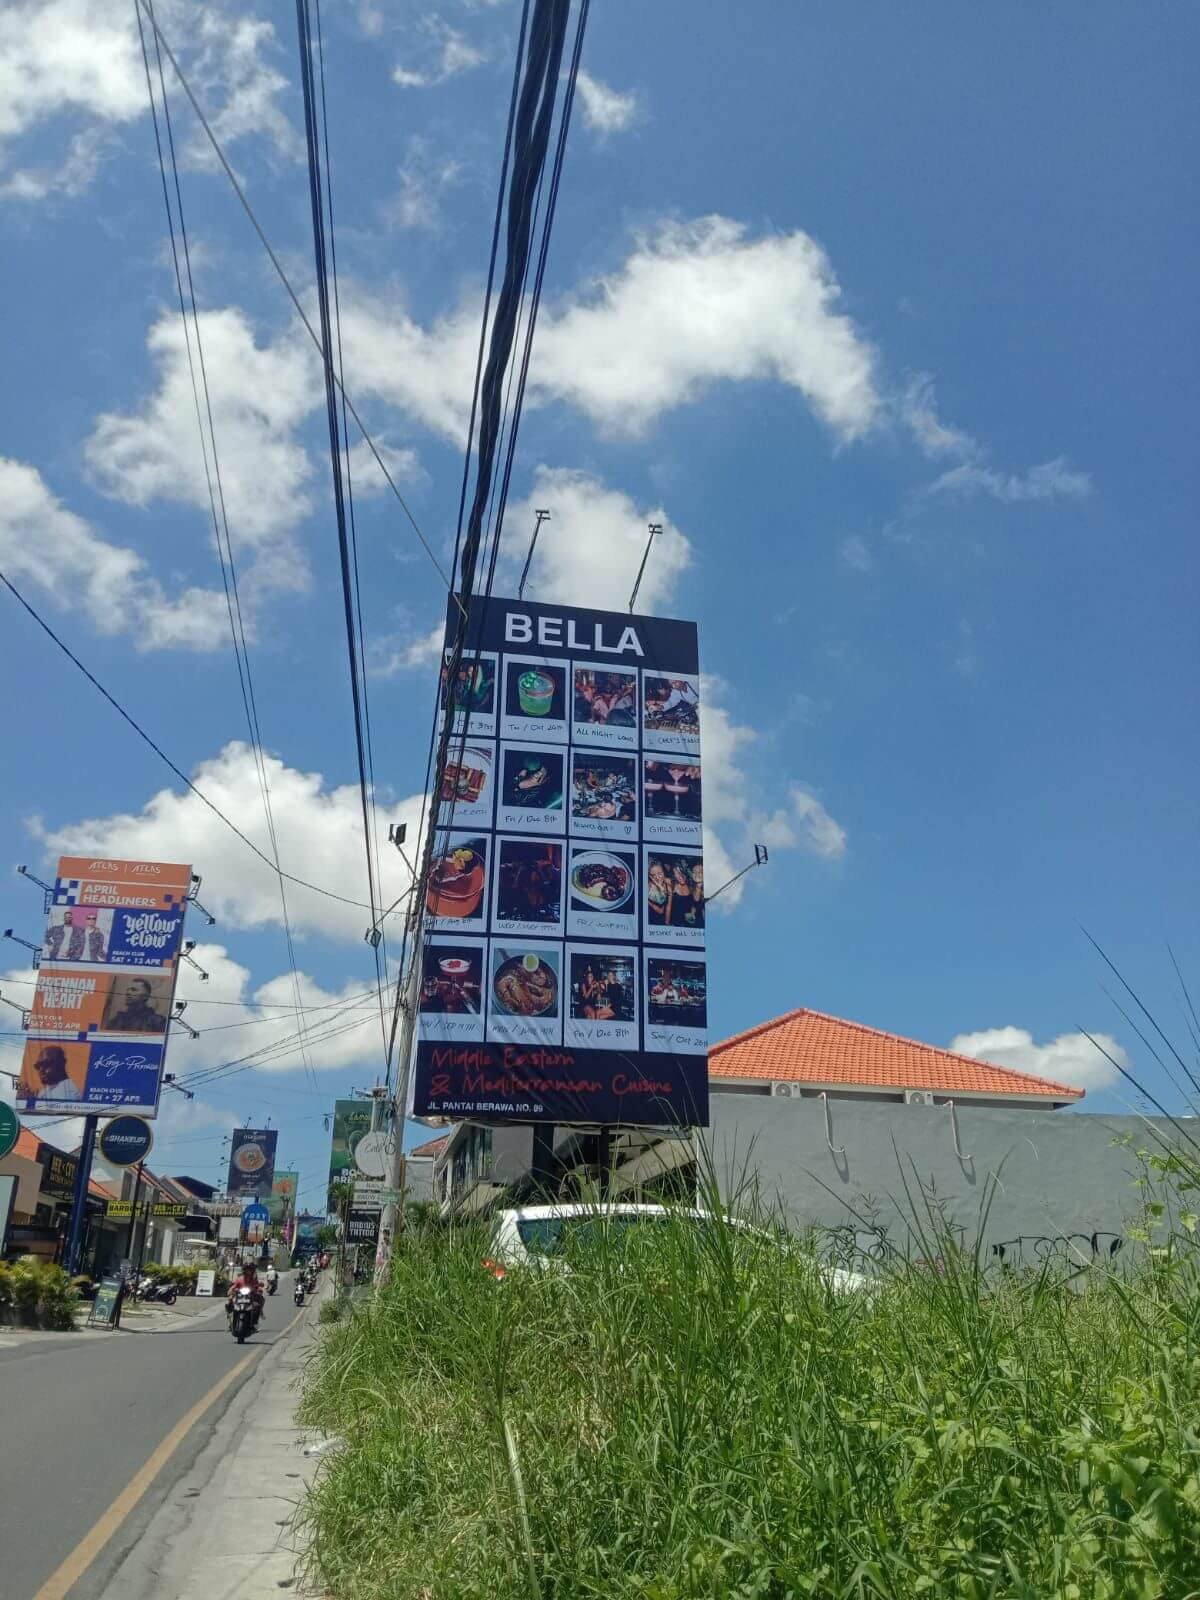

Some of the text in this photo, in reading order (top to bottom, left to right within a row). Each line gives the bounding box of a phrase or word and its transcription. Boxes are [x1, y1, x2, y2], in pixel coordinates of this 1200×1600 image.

[504, 612, 644, 656] BELLA
[576, 728, 589, 736] ALL
[591, 731, 613, 740] NIGHT
[131, 864, 161, 874] ATLAS
[84, 884, 118, 895] APRIL
[82, 894, 157, 907] HEADLINERS
[144, 958, 161, 966] APR
[42, 991, 85, 1009] HEART
[503, 1048, 575, 1069] Eastern
[429, 1074, 449, 1096] &
[611, 1074, 673, 1095] Cuisine
[442, 1102, 474, 1110] PANTAI
[476, 1103, 514, 1112] BERAWA
[515, 1104, 531, 1113] NO.
